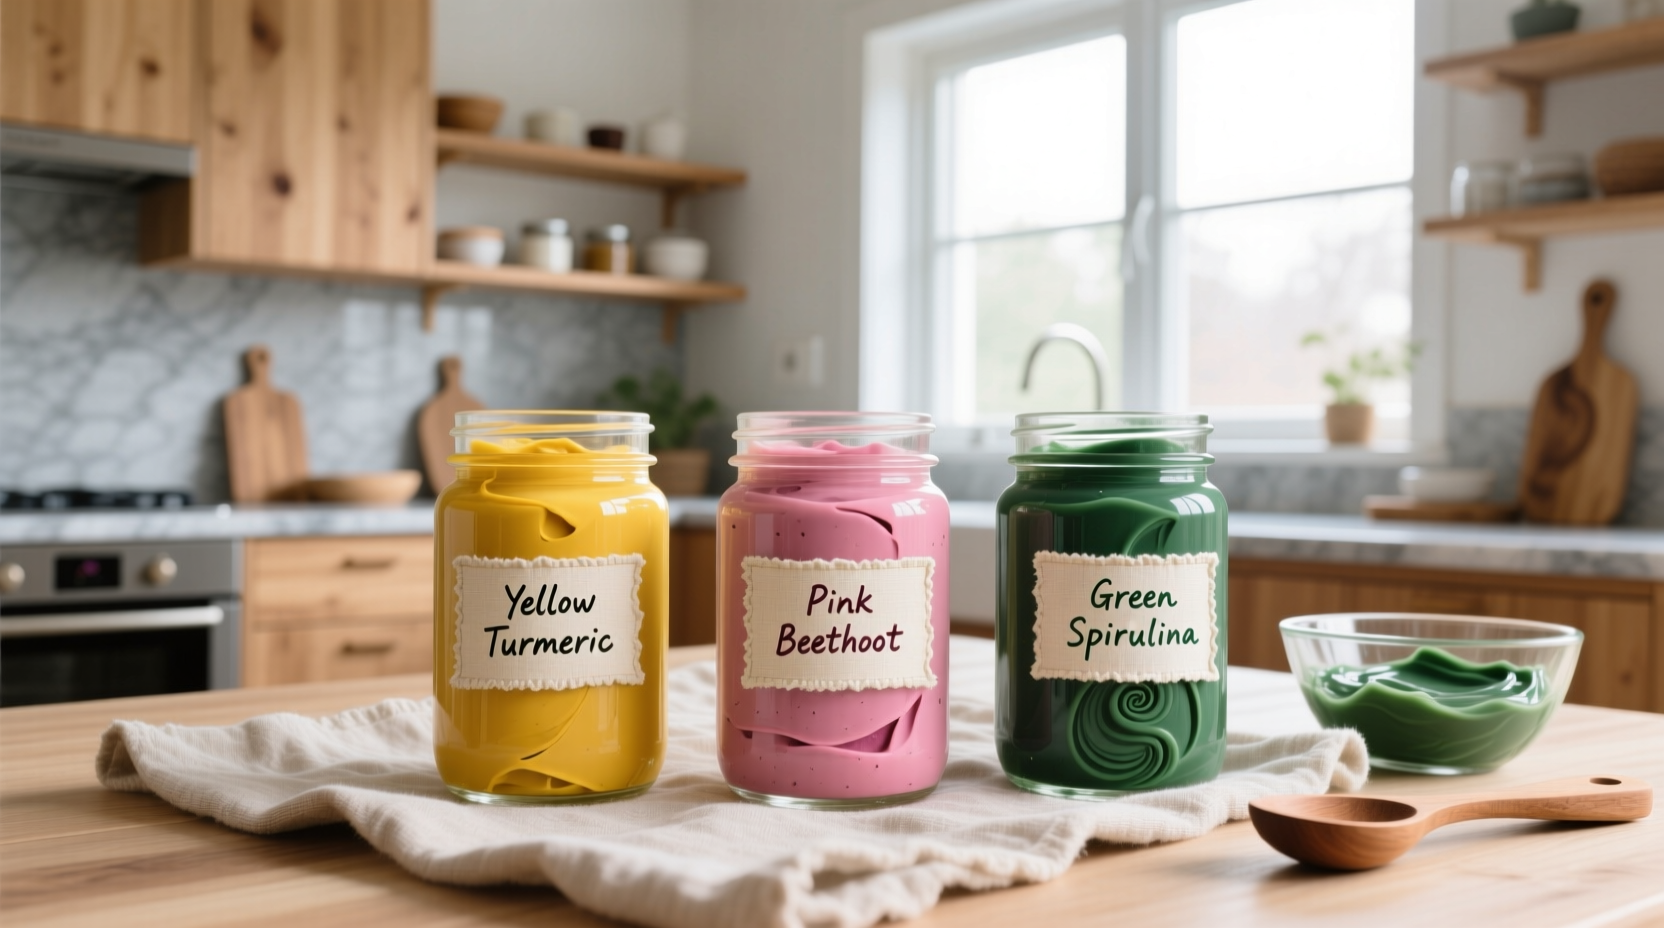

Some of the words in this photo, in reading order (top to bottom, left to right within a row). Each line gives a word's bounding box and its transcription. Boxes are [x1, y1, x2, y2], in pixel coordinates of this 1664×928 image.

[504, 583, 596, 620] Yellow
[806, 583, 873, 617] Pink
[1090, 577, 1178, 611] Green
[483, 624, 614, 658] Turmeric
[775, 622, 904, 657] Beethoot
[1066, 615, 1199, 661] Spirulina
